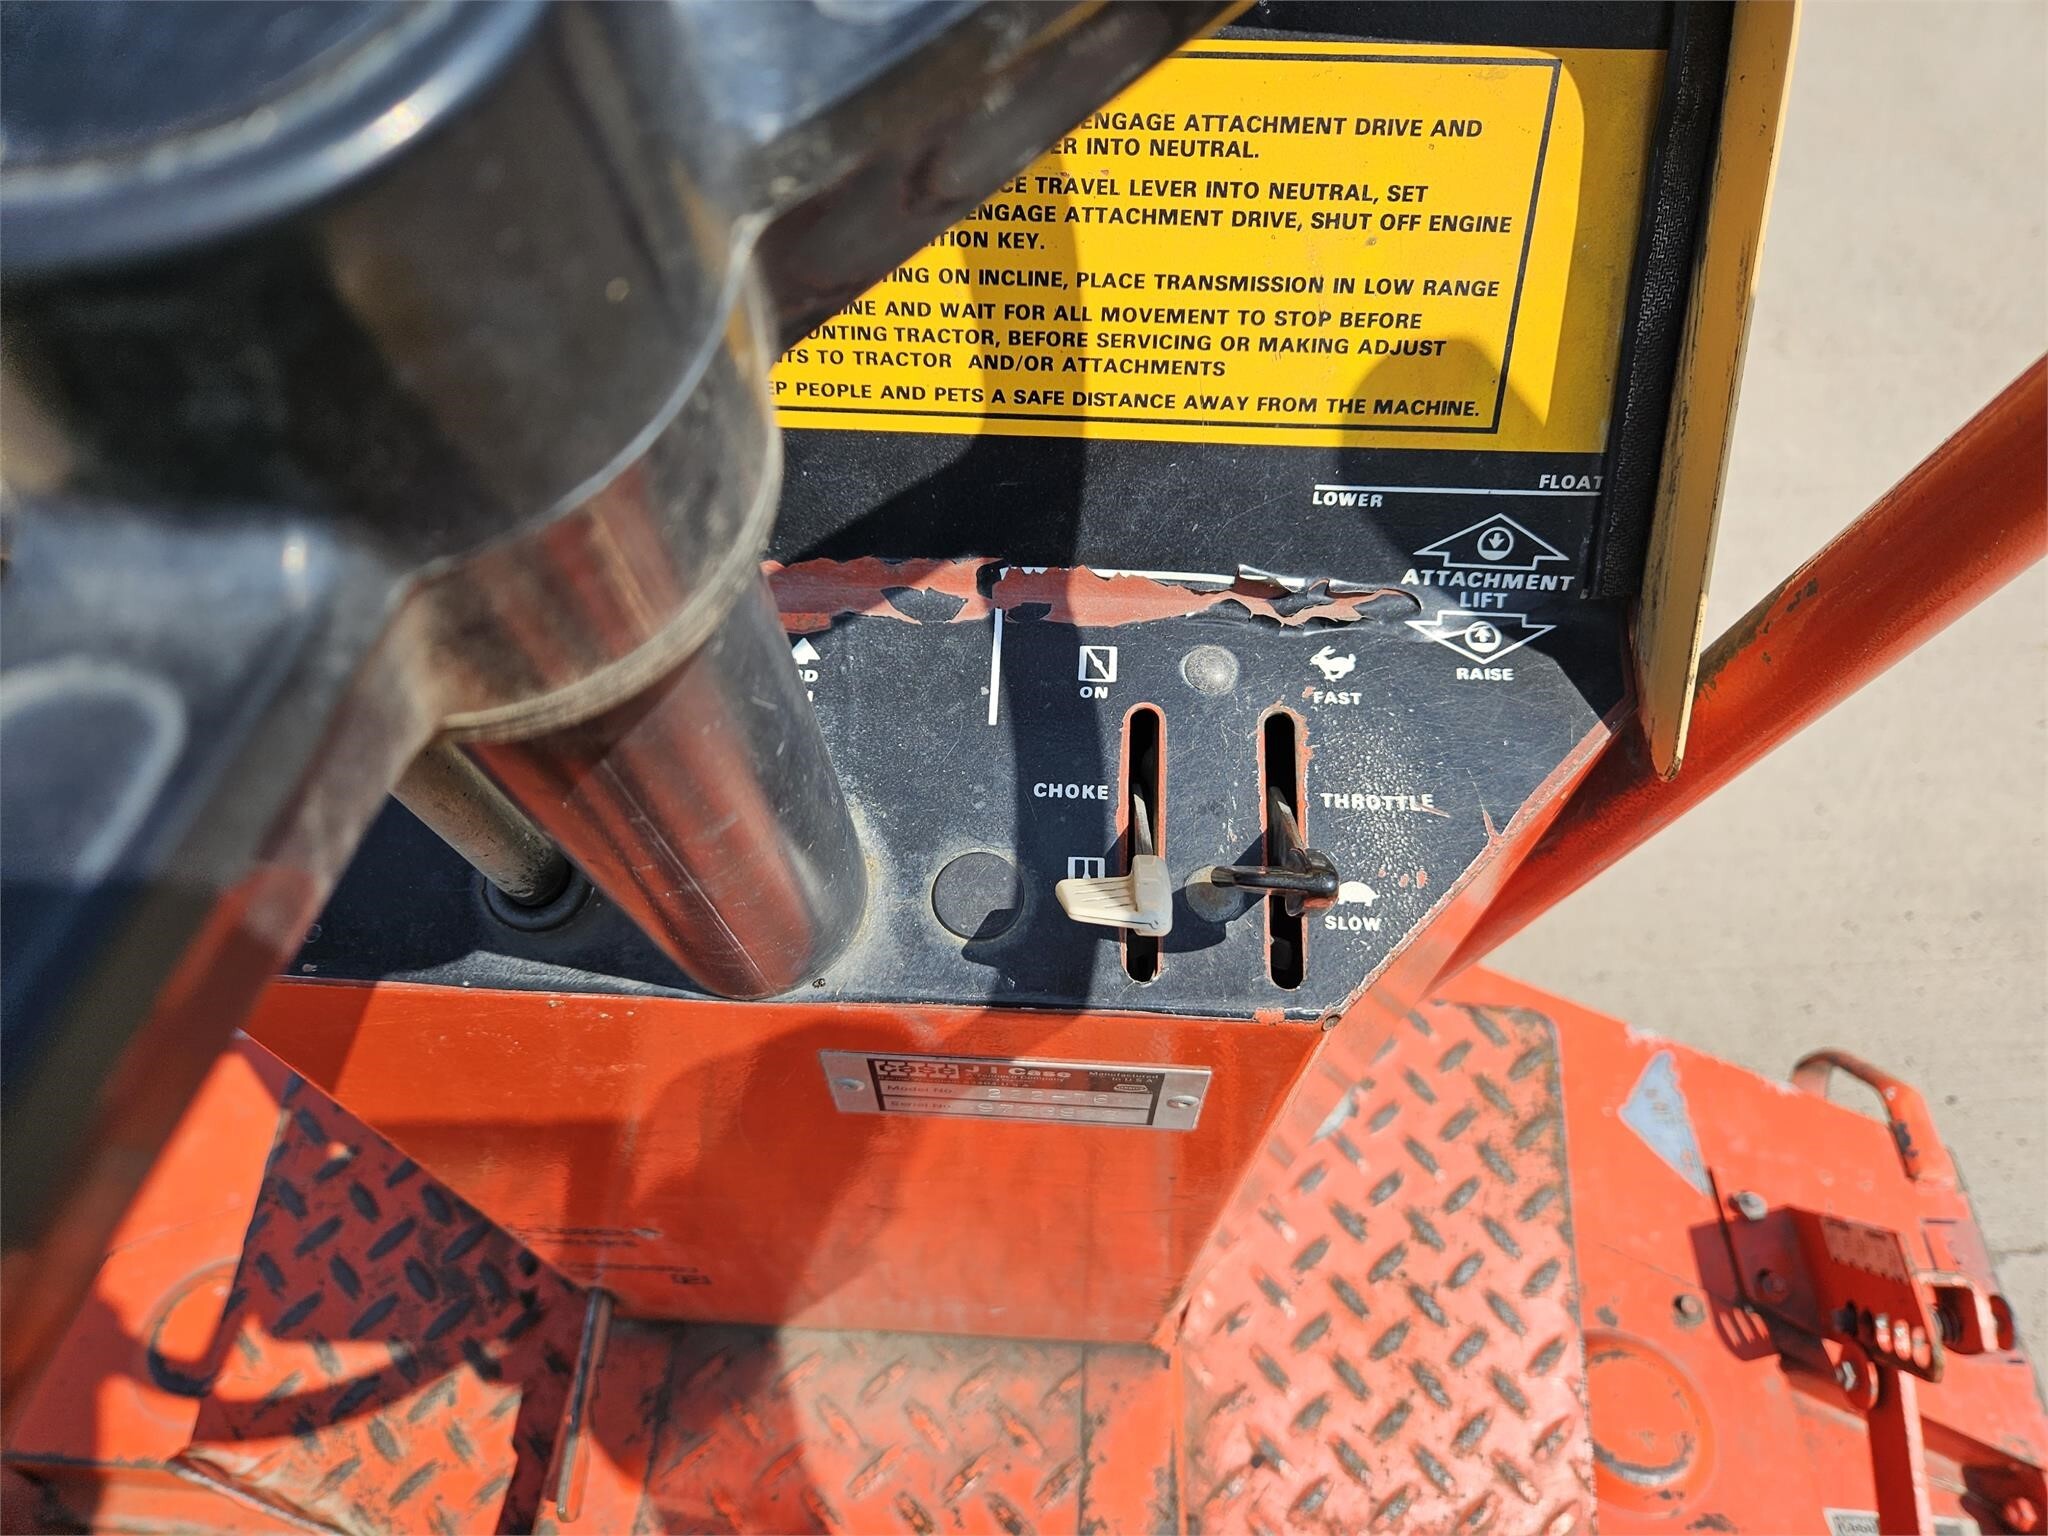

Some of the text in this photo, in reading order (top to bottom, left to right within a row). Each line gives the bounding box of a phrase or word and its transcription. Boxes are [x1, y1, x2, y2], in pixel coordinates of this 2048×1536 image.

[1184, 115, 1347, 134] ATTACHMENT
[1355, 118, 1423, 136] DRIVE
[1430, 120, 1482, 137] AND
[1087, 138, 1140, 156] INTO
[1150, 139, 1258, 158] NEUTRAL.
[1035, 177, 1120, 195] TRAVEL
[1130, 180, 1196, 197] LEVER
[1206, 181, 1259, 199] INTO
[1269, 183, 1378, 204] NEUTRAL,
[1387, 185, 1428, 202] SET
[1064, 207, 1223, 226] ATTACHMENT
[1232, 211, 1302, 231] DRIVE,
[1311, 212, 1372, 229] SHUT
[1380, 214, 1421, 231] OFF
[1429, 215, 1512, 232] ENGINE
[998, 232, 1044, 249] KEY.
[883, 267, 1499, 296] ING ON INCLINE, PLACE TRANSMISSION IN LOW RANGE
[885, 302, 931, 316] AND
[940, 303, 996, 319] WAIT
[1005, 304, 1045, 320] FOR
[1054, 305, 1092, 322] ALL
[1101, 307, 1229, 324] MOVEMENT
[1238, 310, 1265, 325] TO
[1275, 311, 1331, 327] STOP
[1340, 312, 1422, 329] BEFORE
[894, 328, 1000, 348] TRACTOR,
[1009, 330, 1088, 348] BEFORE
[1097, 333, 1211, 350] SERVICING
[1221, 336, 1249, 351] OR
[1259, 337, 1348, 354] MAKING
[1358, 340, 1447, 356] ADJUST
[817, 350, 843, 364] TO
[853, 351, 951, 367] TRACTOR
[969, 354, 1053, 371] AND/OR
[1062, 357, 1225, 376] ATTACHMENTS
[796, 383, 871, 398] PEOPLE
[881, 386, 925, 400] AND
[935, 387, 983, 402] PETS
[991, 389, 1006, 403] A
[1014, 390, 1064, 405] SAFE
[1073, 392, 1175, 408] DISTANCE
[1184, 395, 1248, 410] AWAY
[1257, 397, 1317, 412] FROM
[1327, 399, 1366, 413] THE
[1374, 400, 1479, 416] MACHINE.
[1538, 474, 1603, 489] FLOAT
[1312, 491, 1382, 508] LOWER
[1401, 568, 1574, 591] ATTACHMENT
[1459, 591, 1508, 608] LIFT
[1456, 668, 1514, 681] RAISE
[1080, 686, 1108, 698] ON
[1313, 691, 1362, 705] FAST
[1033, 783, 1108, 800] CHOKE
[1320, 793, 1434, 811] THROTTLE
[1324, 916, 1380, 931] SLOW
[1008, 1067, 1071, 1078] Case
